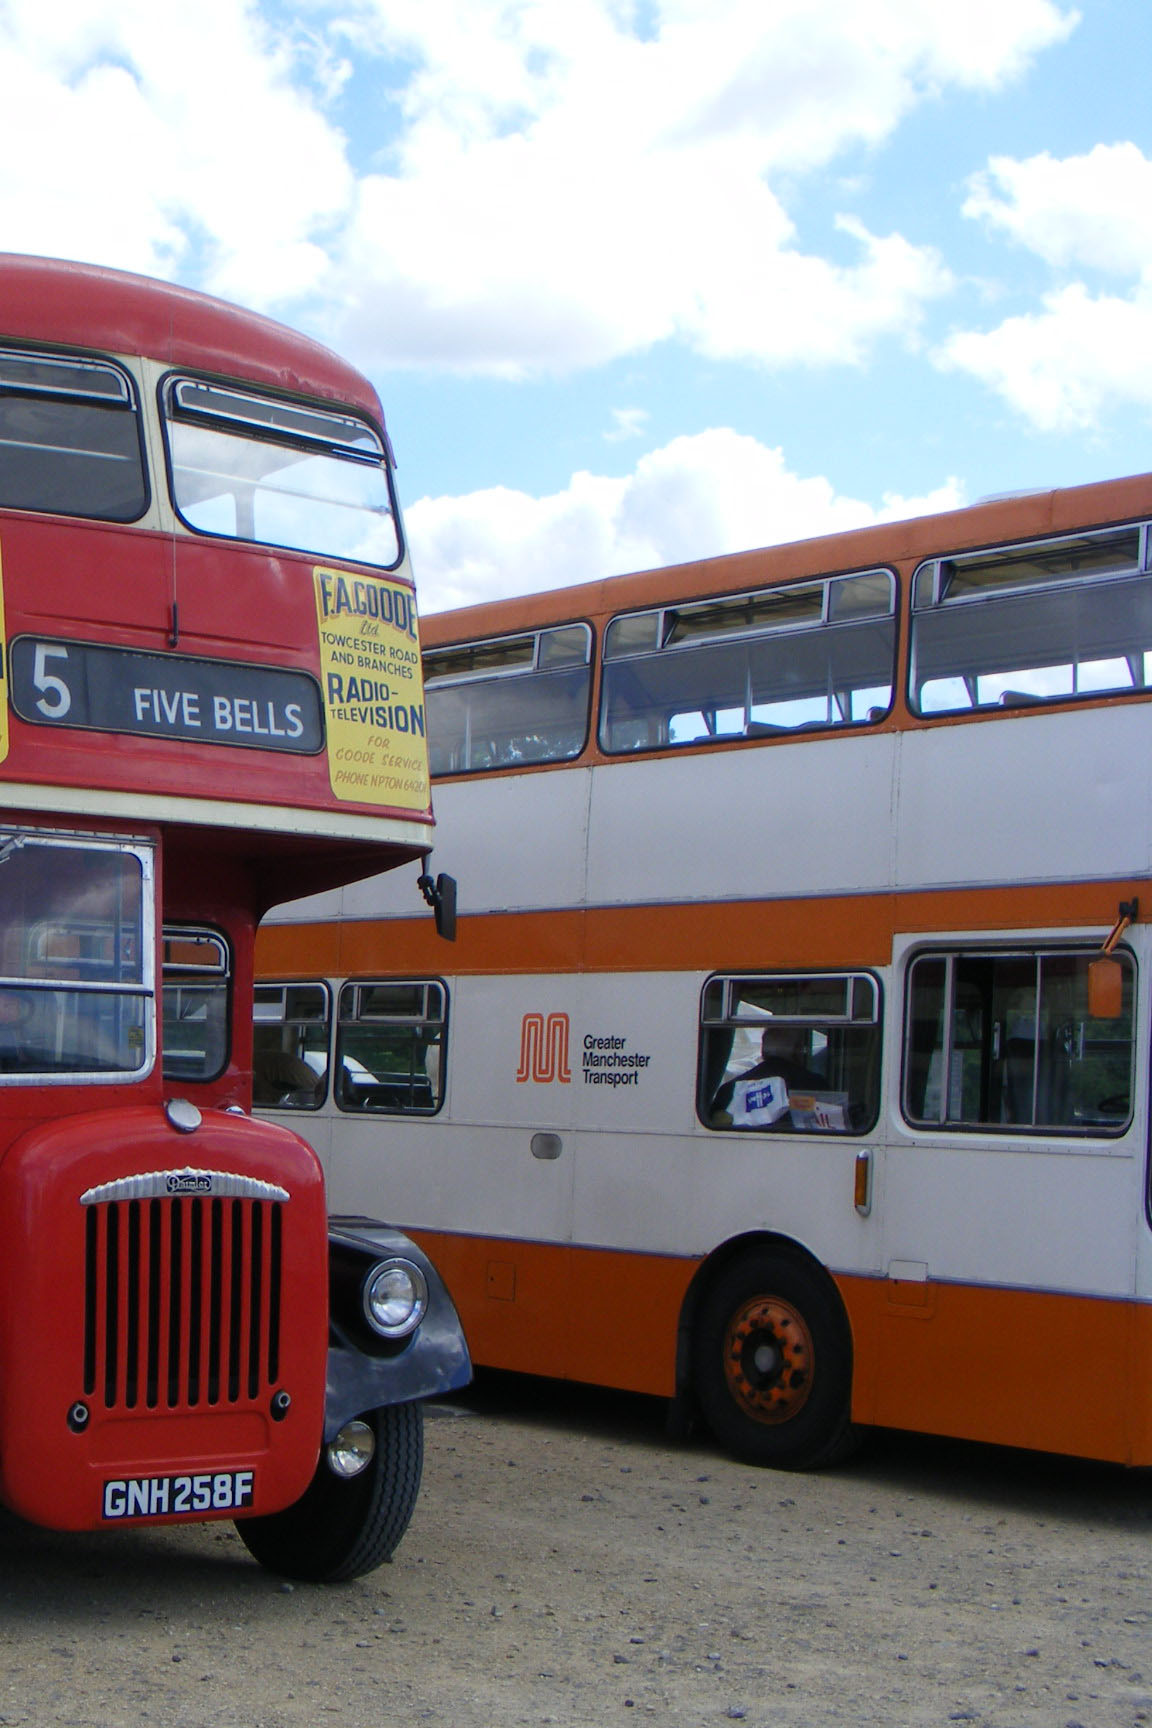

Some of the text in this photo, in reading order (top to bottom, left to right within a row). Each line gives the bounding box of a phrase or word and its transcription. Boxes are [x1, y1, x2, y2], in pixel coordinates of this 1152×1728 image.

[321, 631, 419, 665] TOWCESTER ROAD
[330, 650, 414, 680] AND BRANCHES
[33, 643, 72, 719] 5
[134, 688, 305, 738] FIVE BELLS
[330, 705, 427, 738] TELEVISION
[367, 735, 391, 750] FOR
[335, 748, 424, 772] GOODE SERVICE
[335, 768, 370, 787] PHONE
[583, 1034, 626, 1051] Greater
[582, 1052, 650, 1068] Manchester
[582, 1069, 638, 1088] Transport
